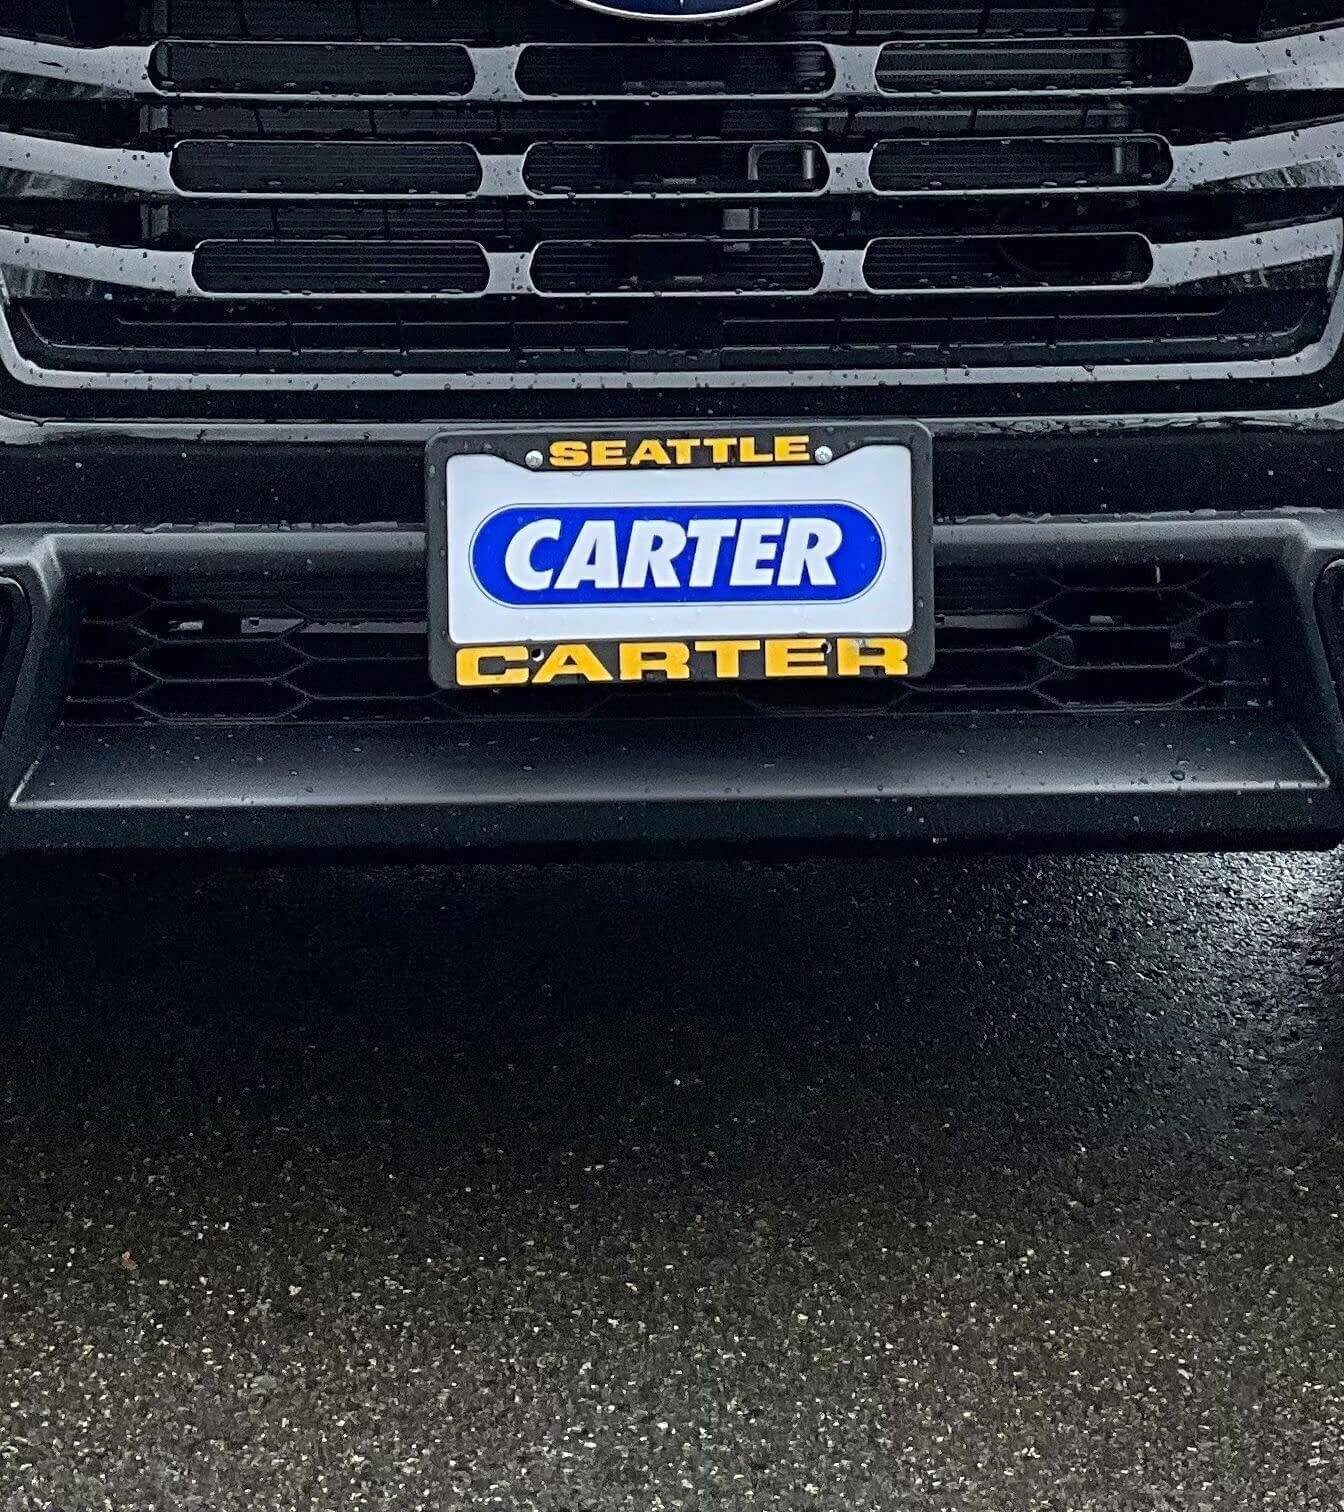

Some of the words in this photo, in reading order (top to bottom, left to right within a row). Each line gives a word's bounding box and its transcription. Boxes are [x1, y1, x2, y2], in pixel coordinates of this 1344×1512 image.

[548, 434, 810, 467] SEATTLE
[504, 516, 844, 591] CARTER
[455, 637, 909, 686] CARTER
